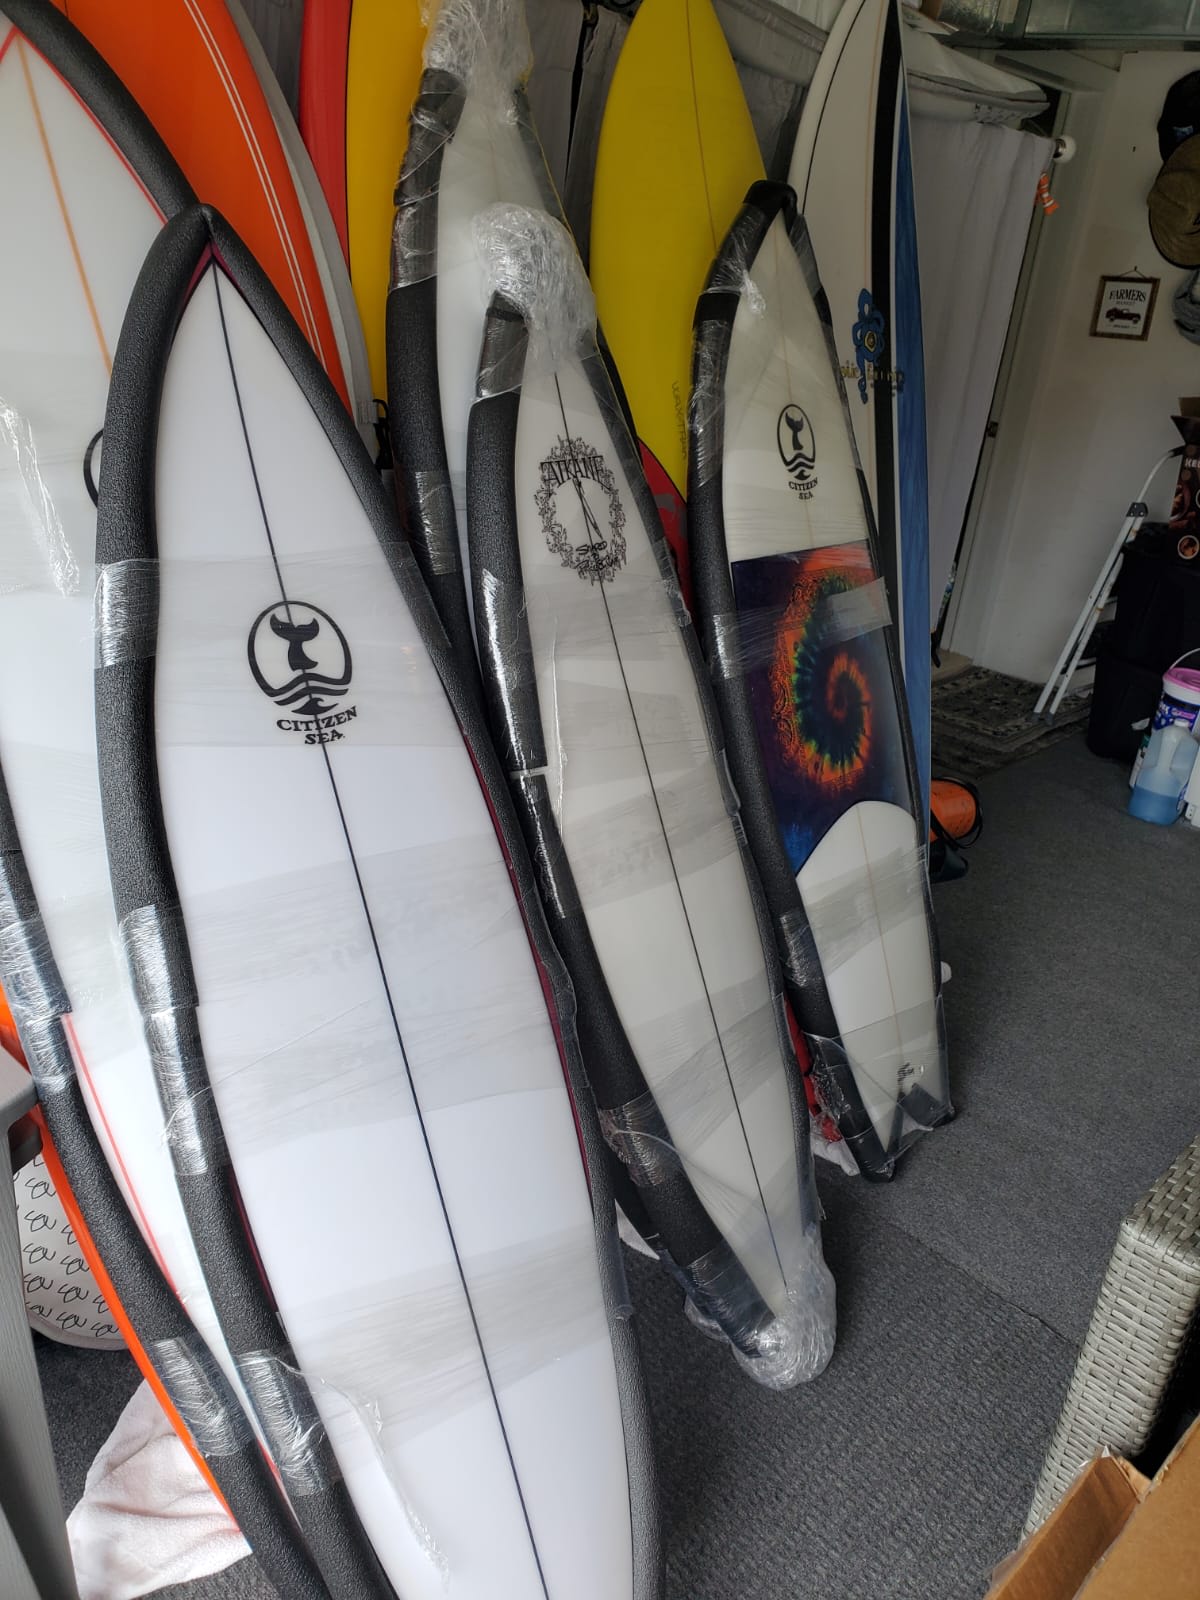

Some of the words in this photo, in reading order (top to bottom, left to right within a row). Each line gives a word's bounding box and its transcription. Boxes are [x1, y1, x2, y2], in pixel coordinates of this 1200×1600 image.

[1110, 288, 1146, 301] FARMERS
[788, 477, 817, 491] CITIZEN
[799, 491, 813, 499] SEA
[277, 706, 357, 732] CITIZEN
[304, 729, 343, 744] SEA
